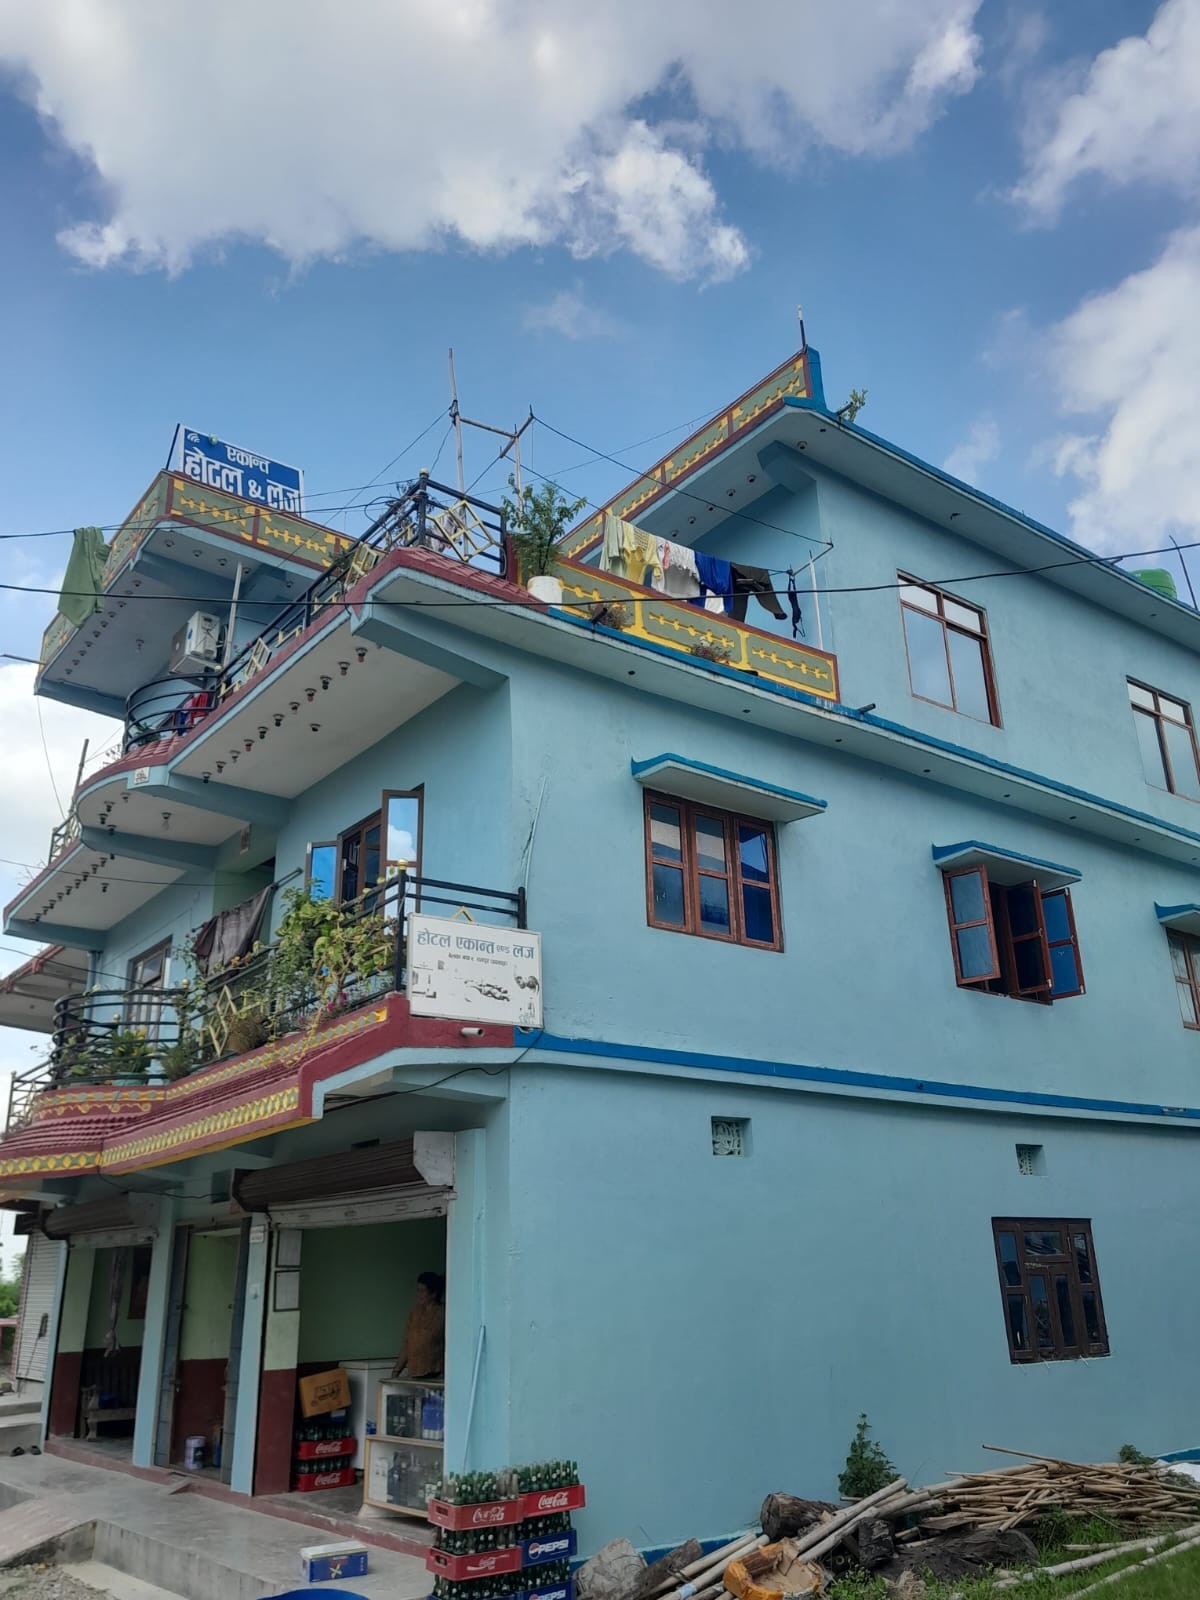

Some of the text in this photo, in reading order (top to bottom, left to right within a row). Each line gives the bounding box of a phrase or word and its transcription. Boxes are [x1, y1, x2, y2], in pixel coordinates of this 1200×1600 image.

[184, 446, 244, 497] होटल
[247, 479, 265, 500] &
[417, 928, 451, 948] होटल
[455, 936, 495, 954] एकान्त
[513, 944, 534, 959] लज
[538, 1539, 569, 1554] PEPSI
